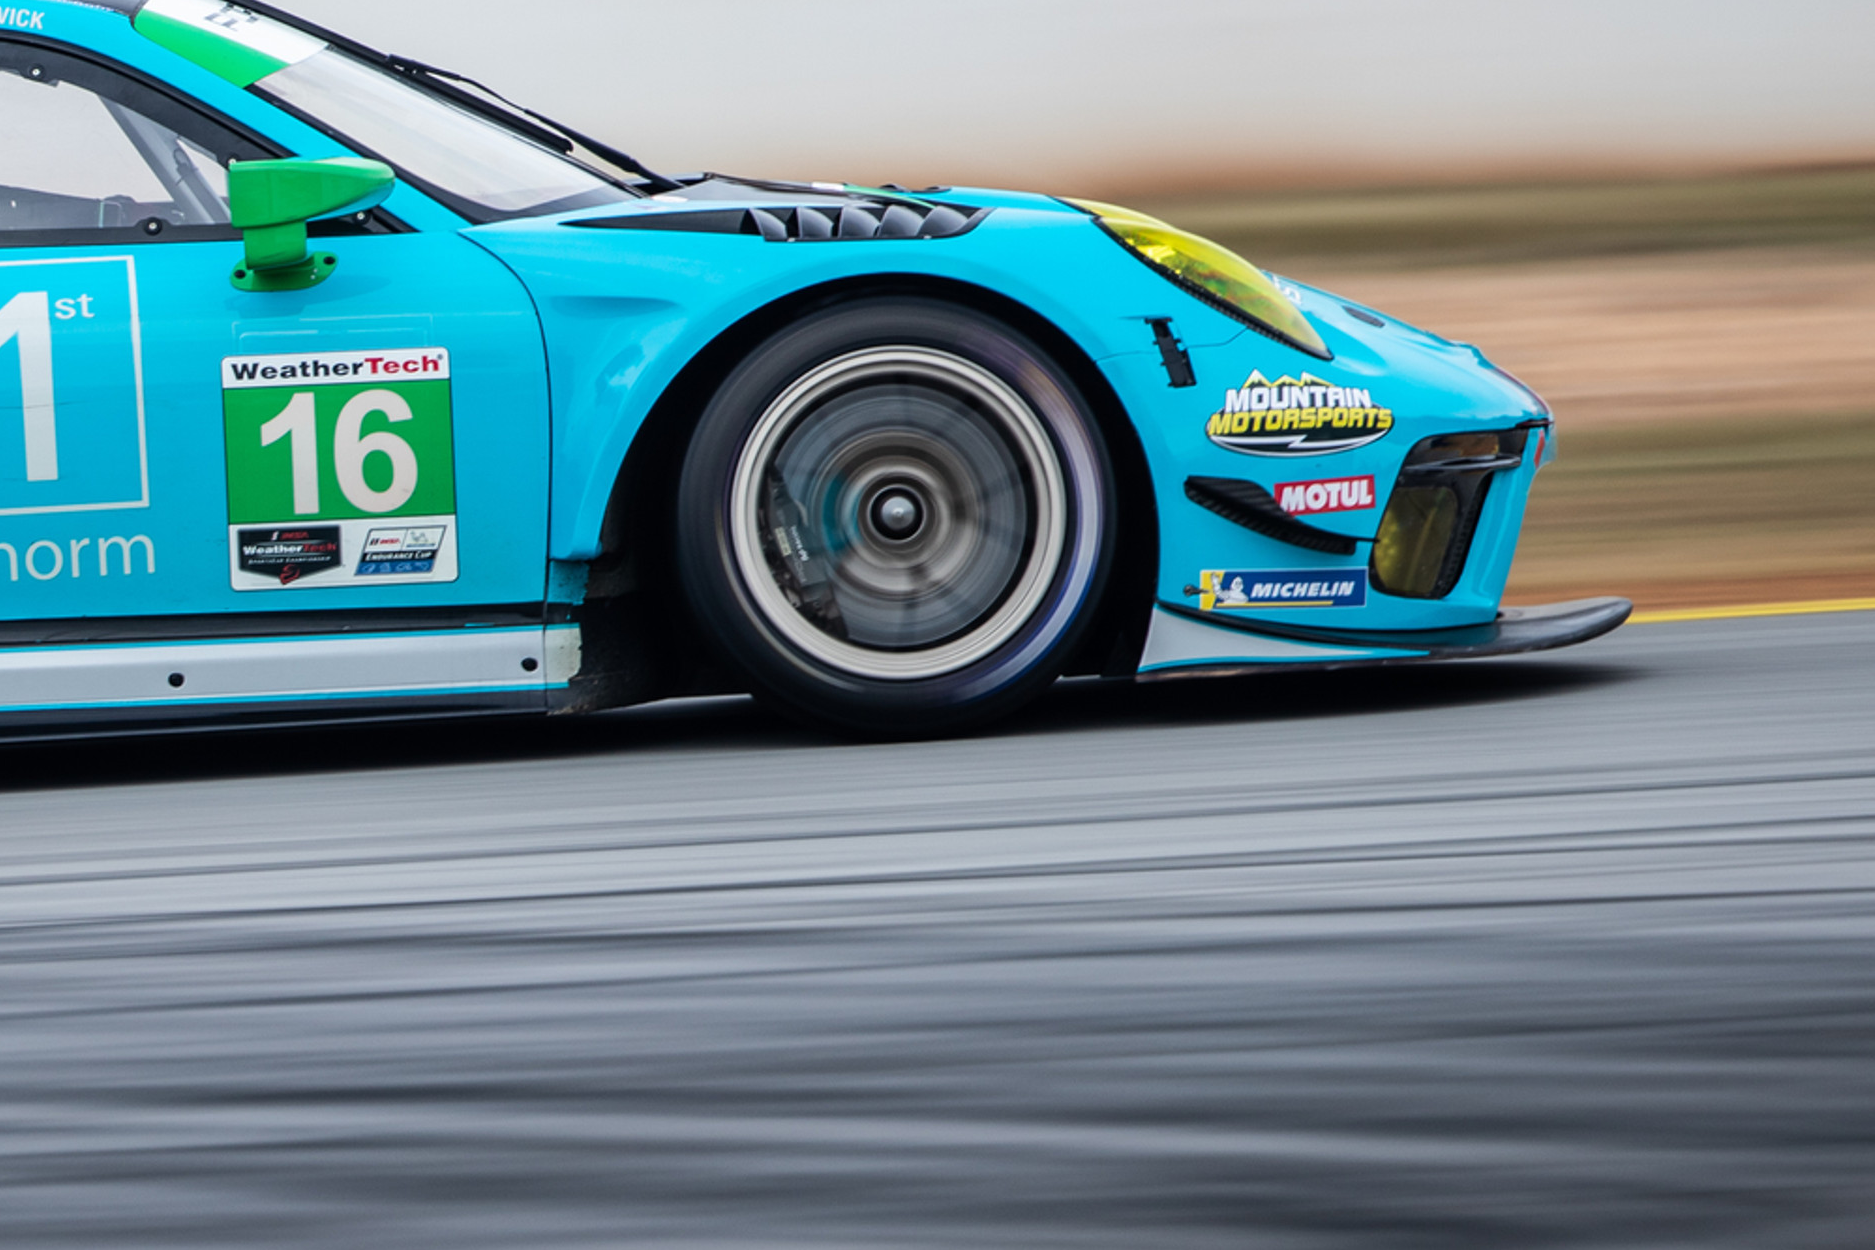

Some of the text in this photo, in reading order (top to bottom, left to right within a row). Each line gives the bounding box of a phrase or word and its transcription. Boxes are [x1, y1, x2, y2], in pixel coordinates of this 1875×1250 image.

[231, 355, 440, 381] WeatherTech
[1225, 385, 1373, 414] MOUNTAIN
[1208, 406, 1393, 436] MOTORSPORTS
[260, 388, 418, 515] 16
[1280, 479, 1373, 512] MOTUL
[242, 541, 337, 556] WeatherTech
[1250, 581, 1355, 598] MICHELIN
